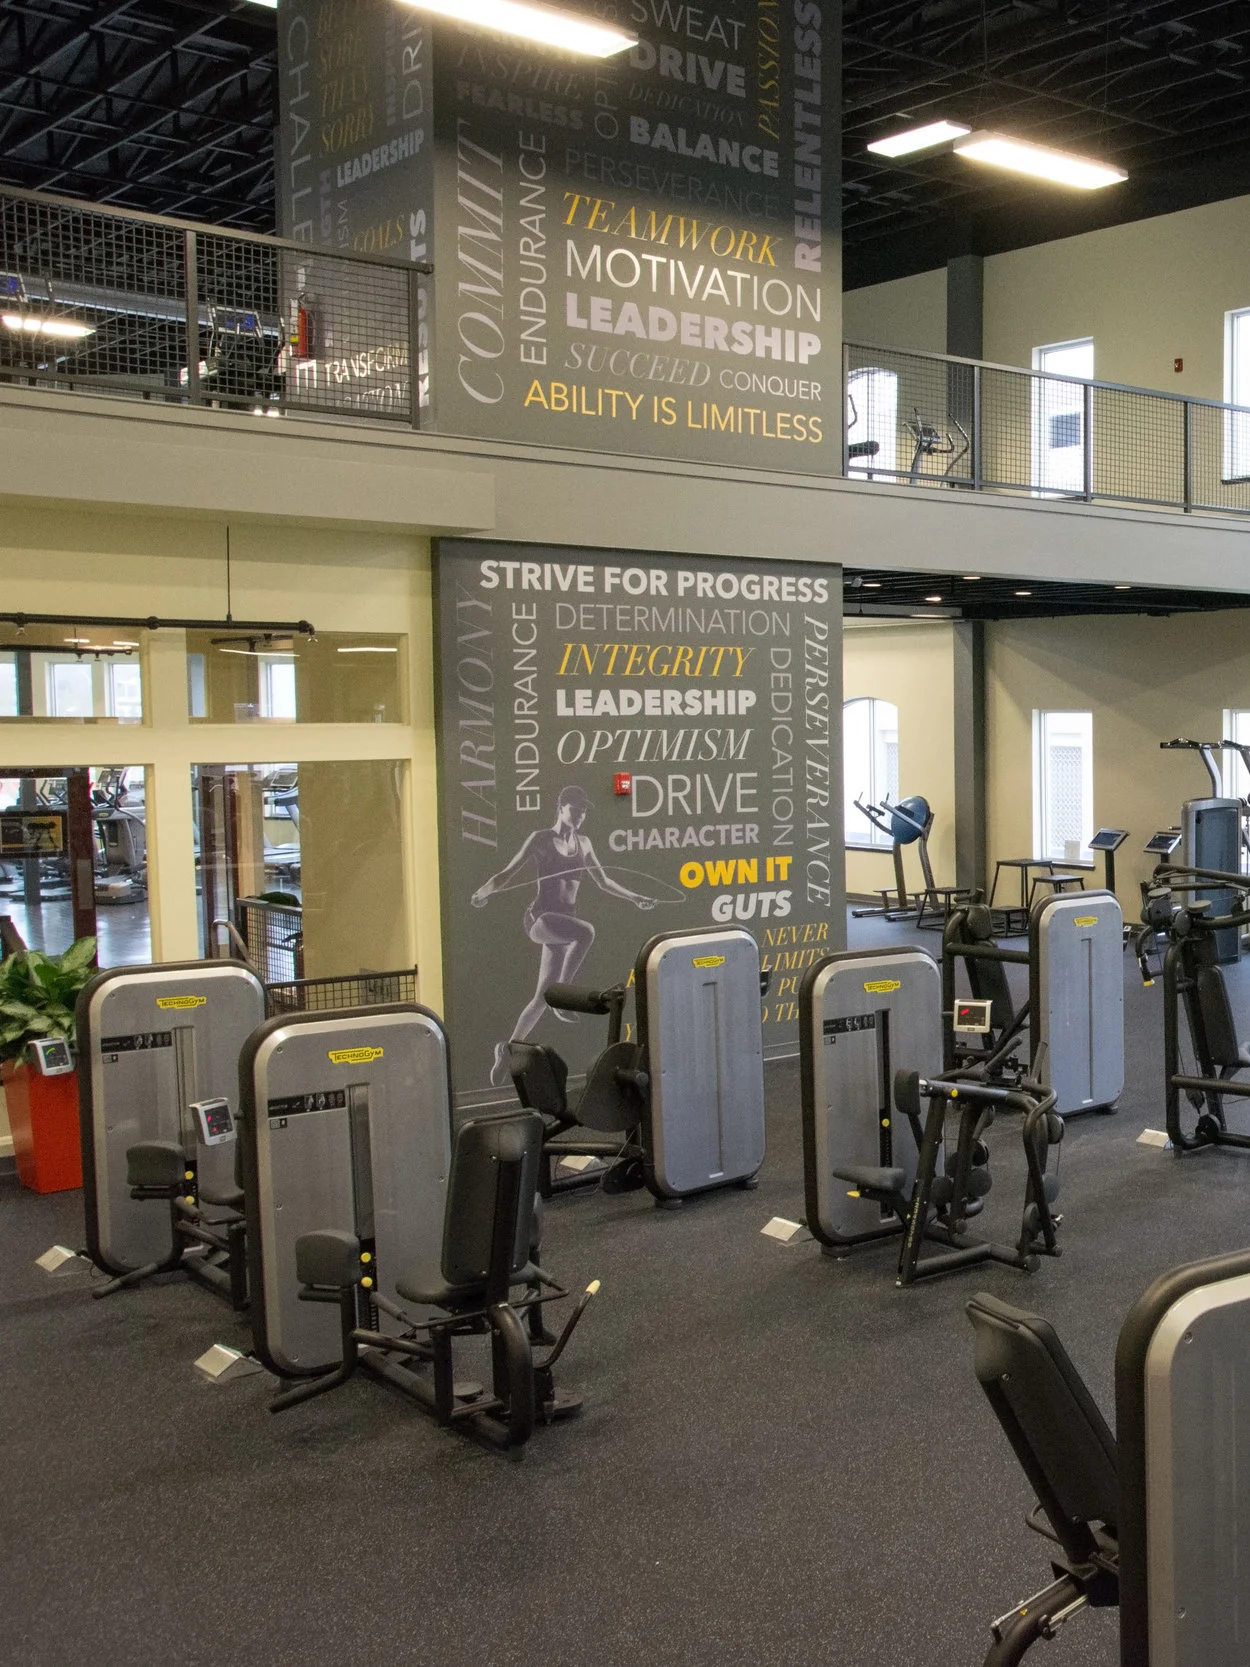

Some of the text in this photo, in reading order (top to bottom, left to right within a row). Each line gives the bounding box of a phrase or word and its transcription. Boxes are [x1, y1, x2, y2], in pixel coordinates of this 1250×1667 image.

[631, 0, 746, 50] SWEAT
[402, 6, 424, 120] DRIV
[629, 36, 747, 99] DRIVE
[456, 80, 585, 131] FEARLESS
[794, 1, 822, 273] RELENTLESS
[336, 128, 425, 188] LEADERSHIP
[630, 115, 780, 178] BALANCE
[565, 146, 779, 220] PERSEVERANCE
[457, 117, 505, 404] COMMIT
[519, 130, 547, 365] ENDURANCE
[562, 191, 784, 268] TEAMWORK
[408, 208, 429, 408] RESUTS
[566, 239, 822, 322] MOTIVATION
[566, 292, 822, 365] LEADERSHIP
[564, 342, 711, 387] SUCCEED
[719, 369, 822, 401] CONQUER
[523, 379, 823, 443] ABILITY IS LIMITLESS
[480, 559, 829, 604] STRIVE FOR PROGRESS
[556, 602, 791, 637] DETERMINATION
[555, 643, 756, 678] INTEGRITY
[456, 583, 498, 851] HARMONY
[512, 602, 540, 812] ENDURANCE
[556, 689, 757, 717] LEADERSHIP
[557, 728, 755, 765] OPTIMISM
[770, 647, 794, 846] DEDICATION
[804, 612, 831, 907] PERSEVERANCE
[631, 772, 759, 818] DRIVE
[608, 823, 760, 852] CHARACTER
[679, 855, 793, 889] OWN IT
[711, 890, 792, 922] GUTS
[761, 922, 829, 948] NEVER
